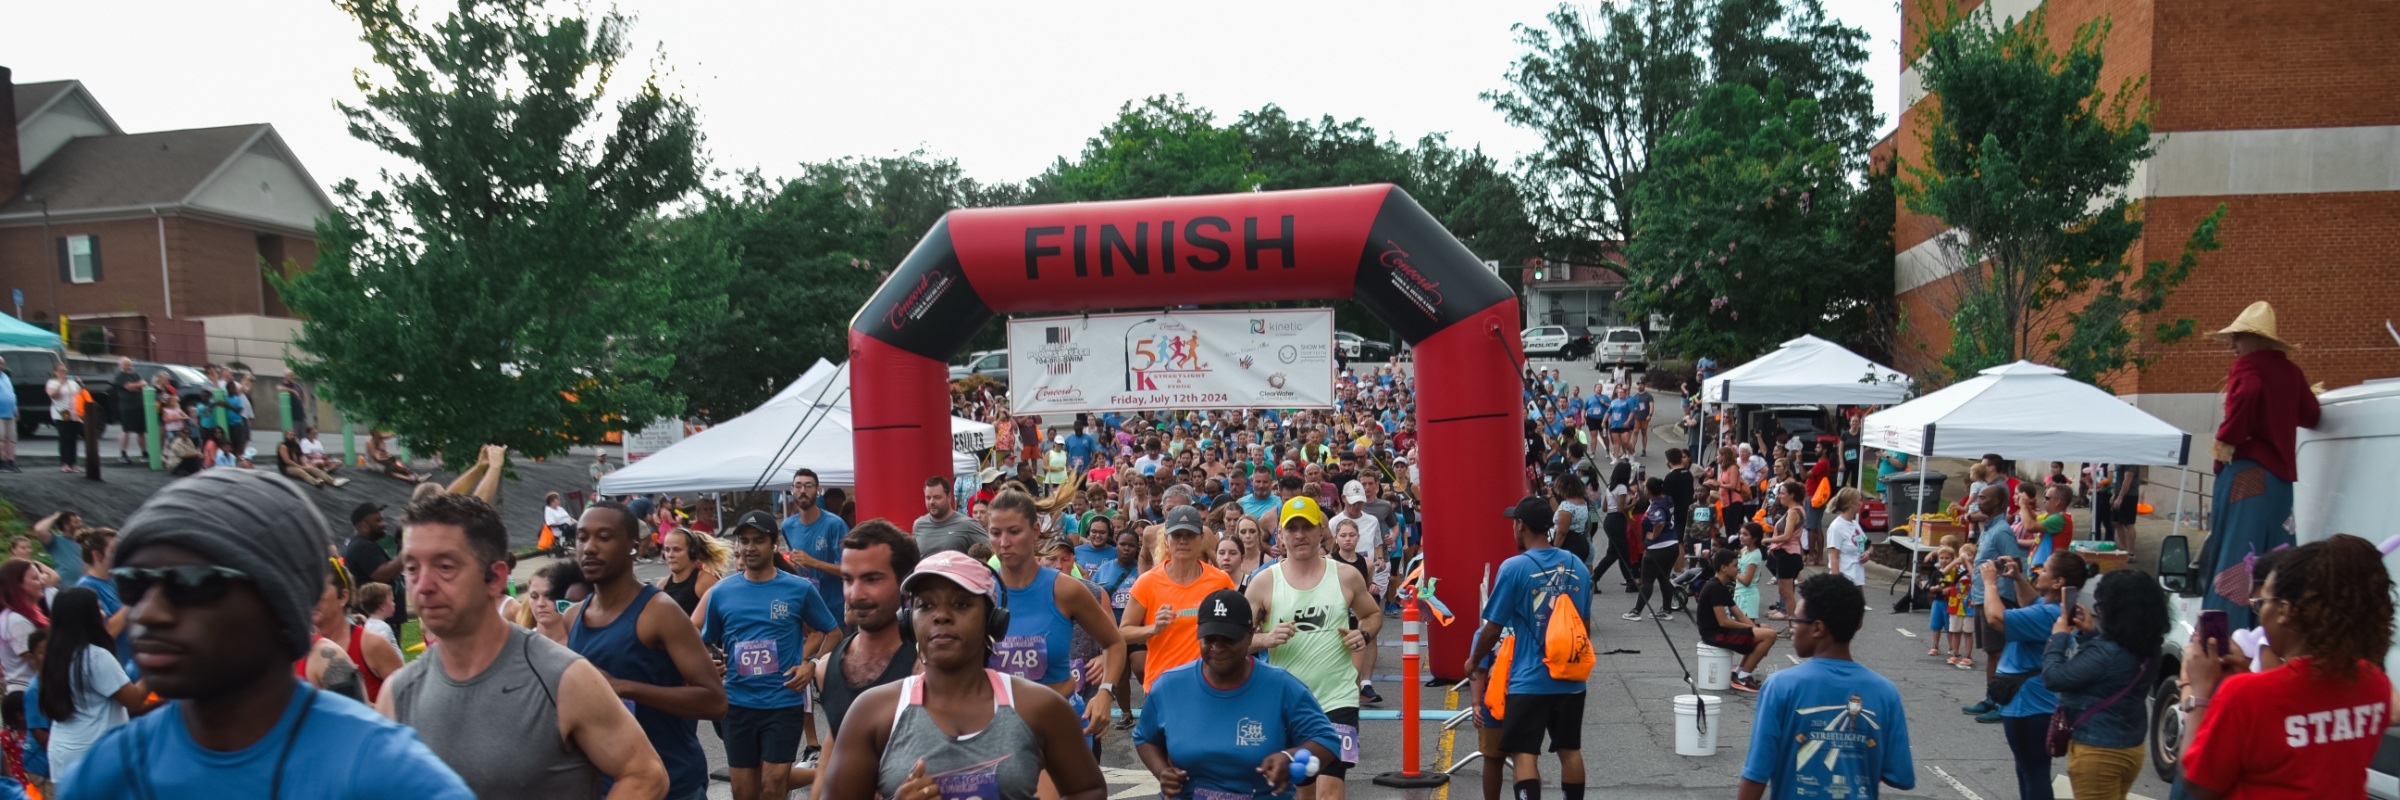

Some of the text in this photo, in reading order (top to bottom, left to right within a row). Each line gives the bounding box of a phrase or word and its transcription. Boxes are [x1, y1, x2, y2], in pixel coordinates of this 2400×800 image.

[1024, 215, 1296, 280] FINISH
[1380, 239, 1443, 305] Concord
[882, 270, 941, 329] Concord
[1269, 322, 1303, 331] kinetic
[1131, 339, 1156, 371] 5
[1136, 370, 1158, 391] K
[1034, 384, 1082, 402] Concord
[1111, 393, 1228, 406] Friday, July 12th 2024
[953, 431, 985, 450] ESULTS
[1213, 599, 1228, 617] LA
[740, 649, 772, 666] 673
[998, 649, 1039, 669] 748
[2284, 702, 2386, 748] STAFF
[1810, 731, 1867, 743] STREETLIGHT
